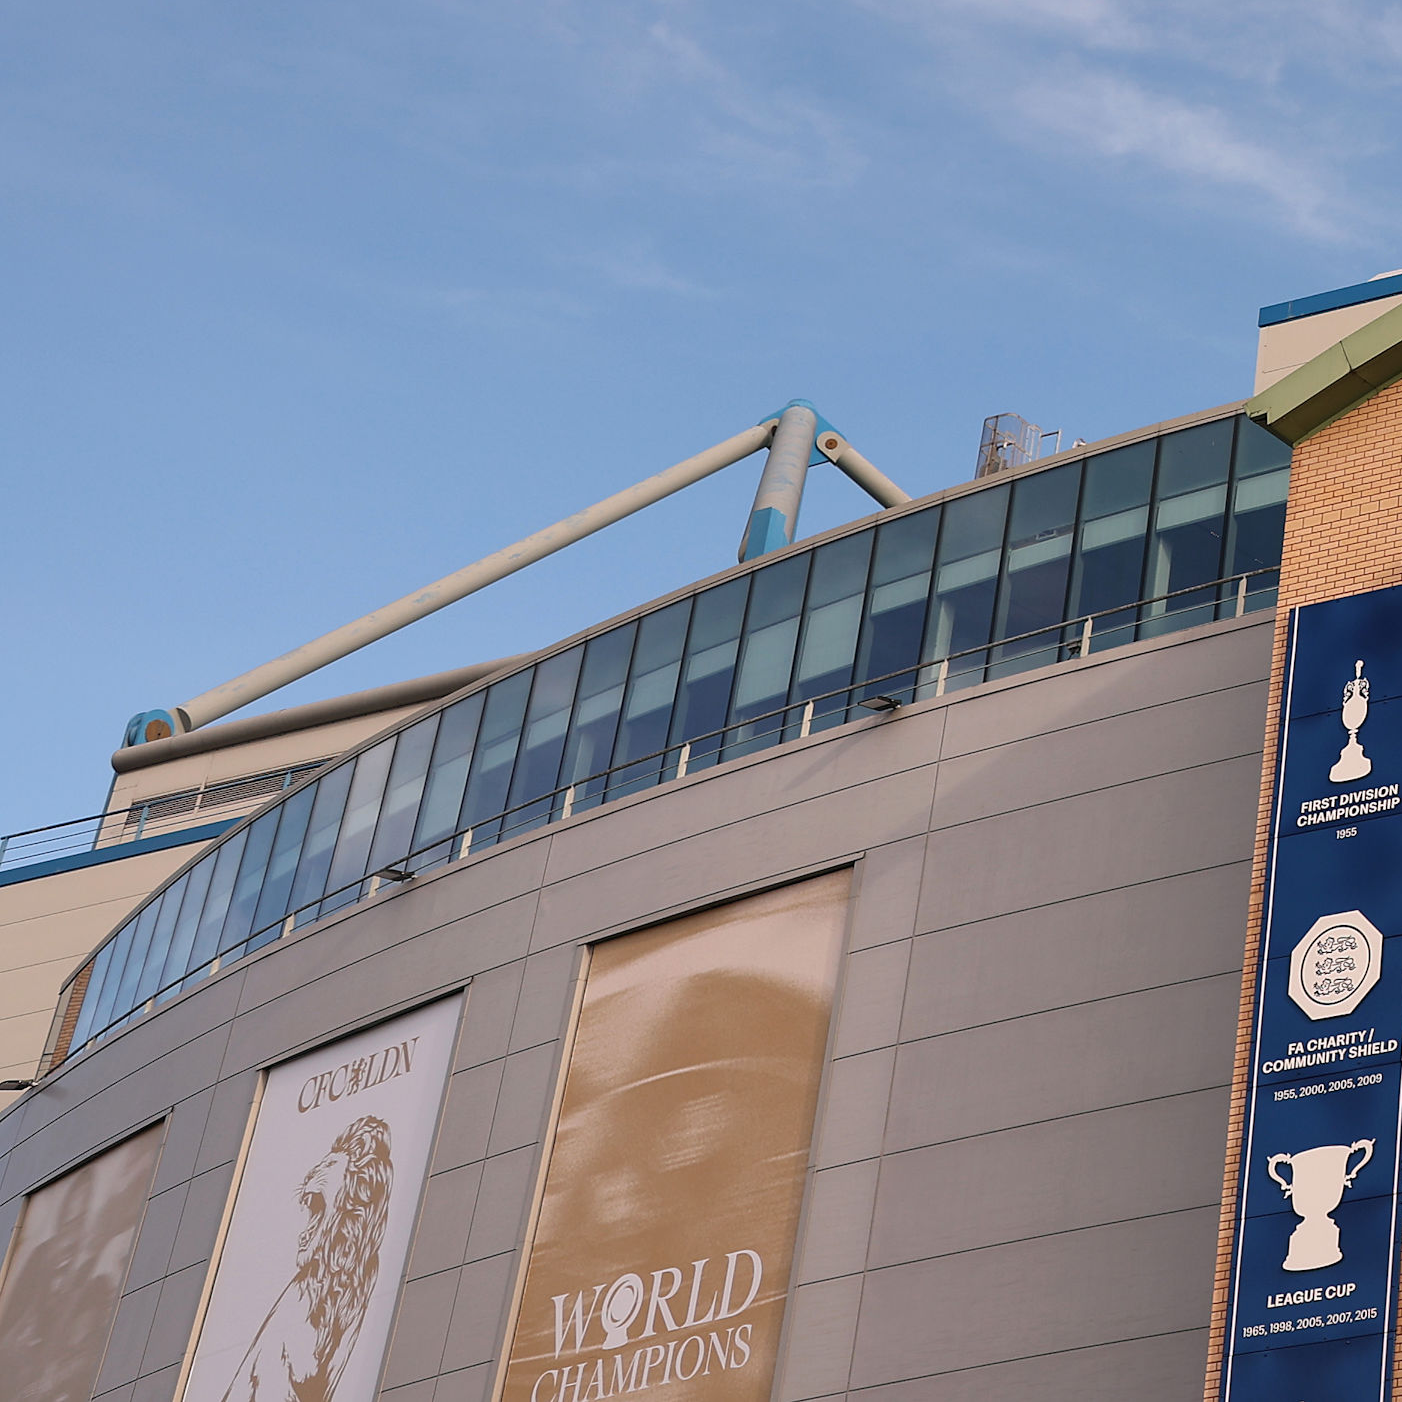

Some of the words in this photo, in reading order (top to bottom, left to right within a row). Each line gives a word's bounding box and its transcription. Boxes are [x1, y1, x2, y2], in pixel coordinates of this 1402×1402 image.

[1296, 797, 1401, 827] CHAMPIONSHIP
[1301, 796, 1338, 813] FIRST
[1339, 783, 1399, 806] DIVISION
[1335, 827, 1358, 840] 1955
[1262, 1048, 1347, 1074] COMMUNITY
[1348, 1039, 1398, 1059] SHIELD
[1288, 1042, 1305, 1056] FA
[1306, 1030, 1367, 1052] CHARITY
[297, 1064, 349, 1114] CFC
[360, 1036, 420, 1091] LDN
[1273, 1088, 1298, 1102] 1955,
[1299, 1083, 1327, 1097] 2000,
[1328, 1078, 1356, 1092] 2005,
[1357, 1073, 1383, 1087] 2009
[1266, 1287, 1323, 1309] LEAGUE
[1325, 1282, 1356, 1300] CUP
[1242, 1325, 1268, 1338] 1965,
[1270, 1320, 1295, 1334] 1998,
[1296, 1316, 1325, 1330] 2005,
[1326, 1311, 1353, 1325] 2007,
[1354, 1307, 1378, 1321] 2015
[530, 1323, 753, 1402] CHAMPIONS
